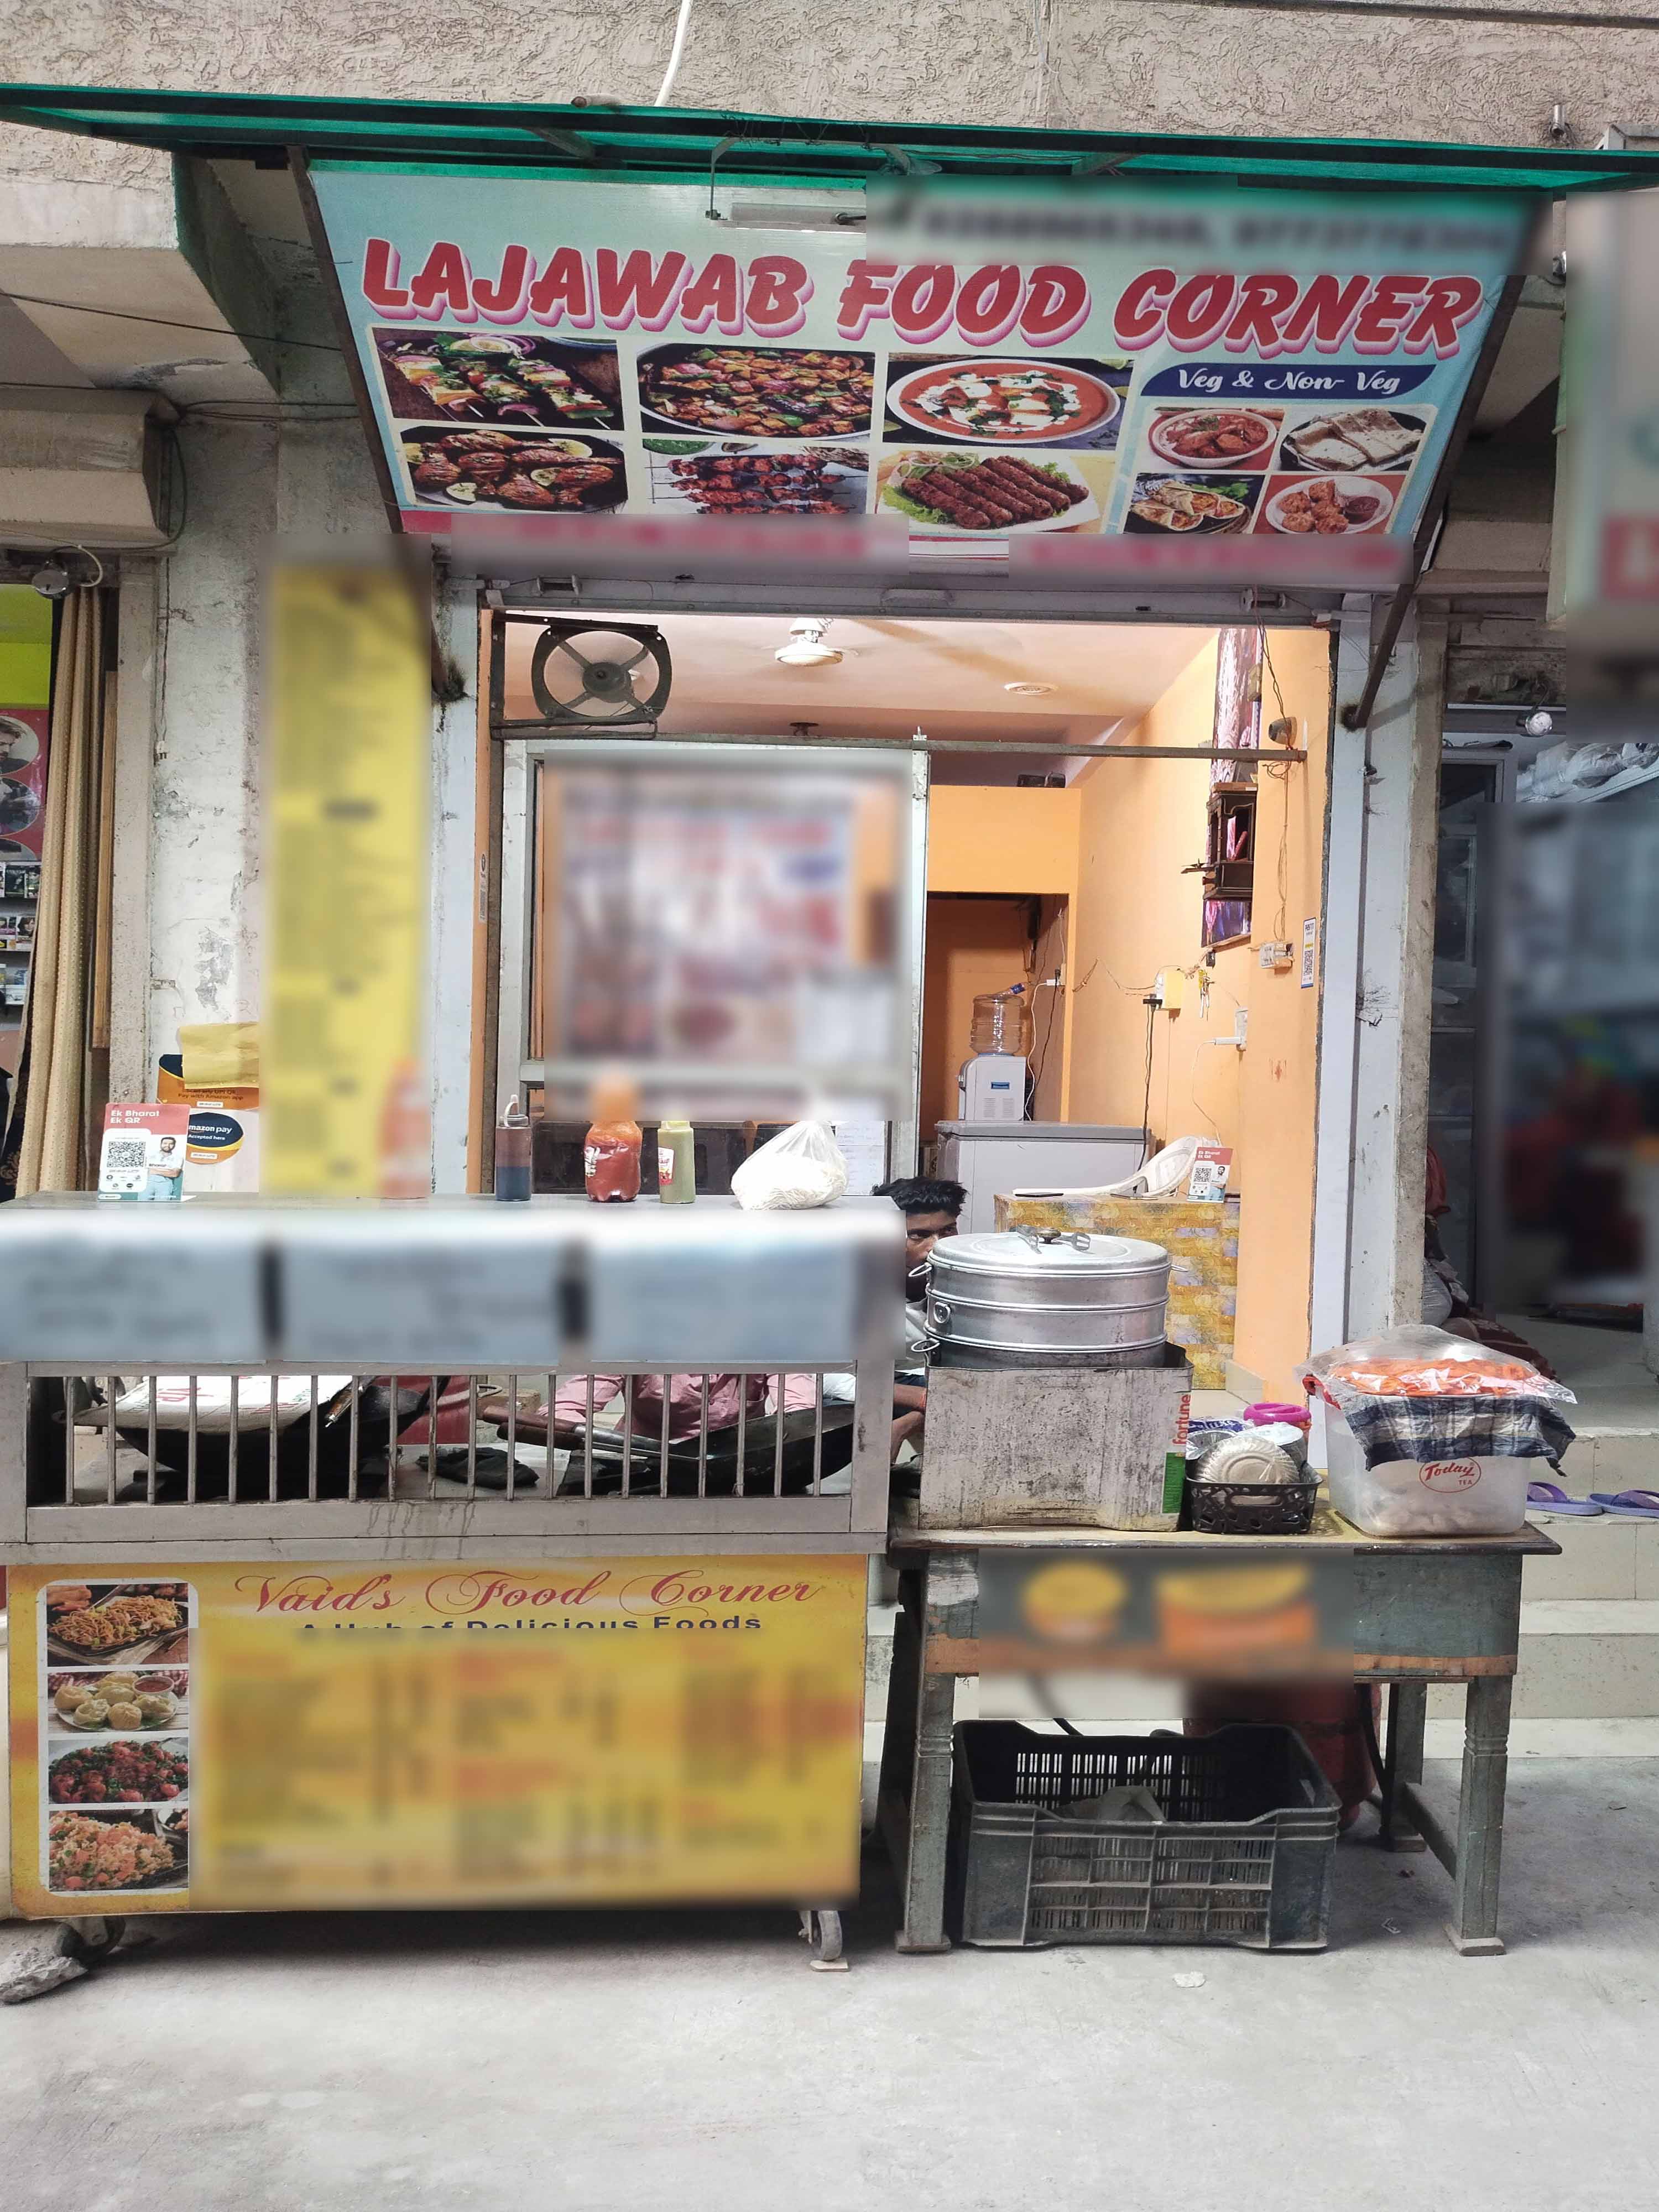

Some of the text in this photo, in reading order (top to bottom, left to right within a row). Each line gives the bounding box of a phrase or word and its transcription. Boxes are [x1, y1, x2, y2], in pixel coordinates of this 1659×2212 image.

[363, 237, 1483, 359] LAJAWAB FOOD CORNER
[1178, 367, 1223, 393] Veg
[1232, 369, 1254, 388] &
[1357, 370, 1401, 394] Veg
[1172, 1394, 1191, 1445] fortune
[1425, 1462, 1475, 1481] Today
[234, 1569, 826, 1617] Vaid's Food Corner
